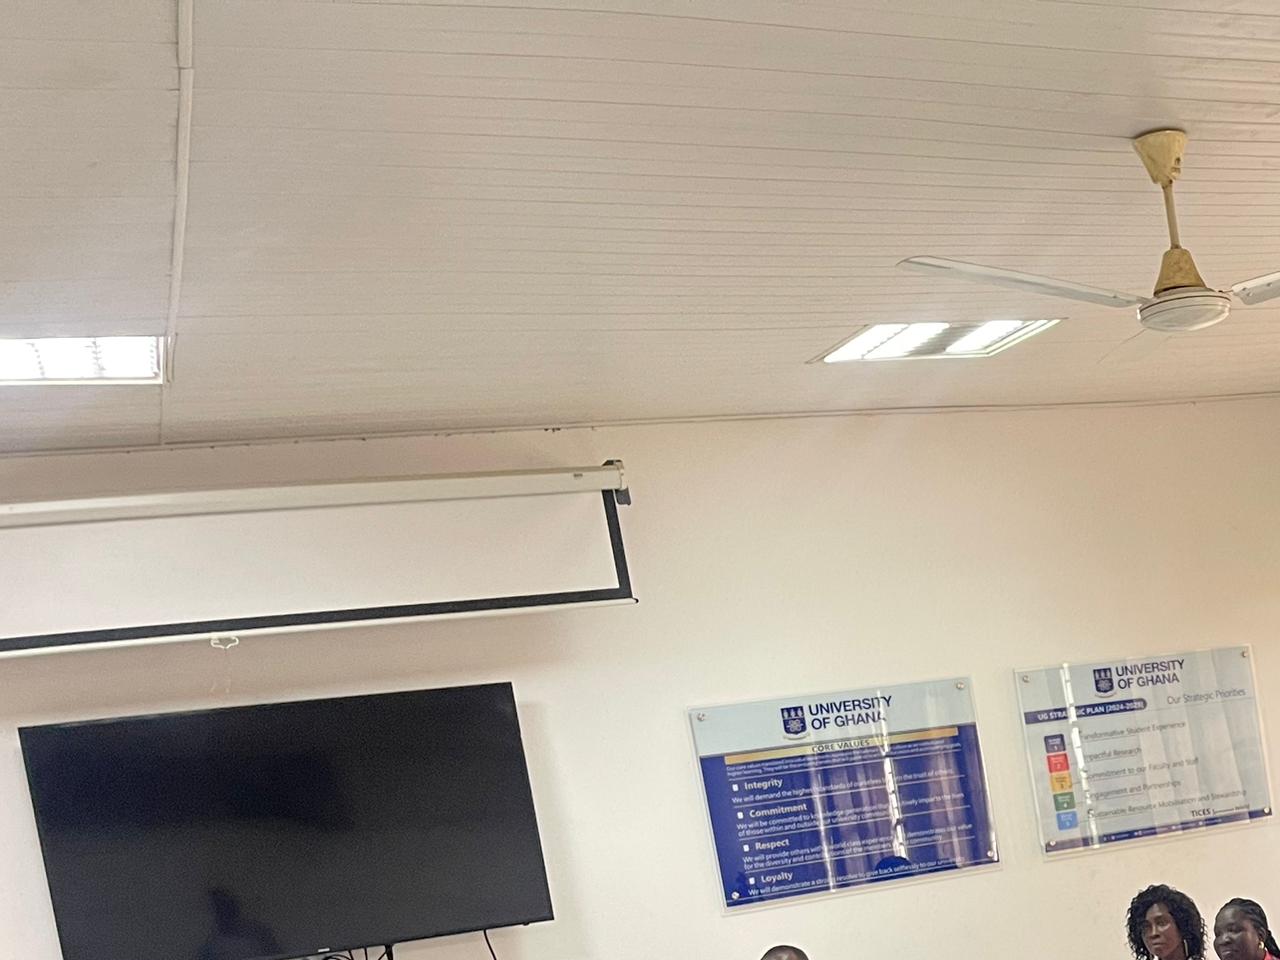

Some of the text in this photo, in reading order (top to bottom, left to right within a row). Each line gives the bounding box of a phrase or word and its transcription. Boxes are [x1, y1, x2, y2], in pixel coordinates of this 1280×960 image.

[1116, 659, 1185, 677] UNIVERSITY
[1118, 673, 1180, 690] OF GHANA
[1167, 688, 1246, 705] Our Strategic Priorities
[808, 695, 893, 716] UNIVERSITY
[1049, 709, 1086, 719] STRAIC
[1086, 706, 1105, 715] PLAN
[811, 710, 887, 730] OF GHANA
[812, 740, 870, 753] CORE VALUES
[1084, 750, 1111, 760] mpactful
[744, 778, 784, 790] Integrity
[749, 803, 807, 818] Commitment
[755, 839, 789, 850] Respect
[761, 872, 794, 883] Loyalty
